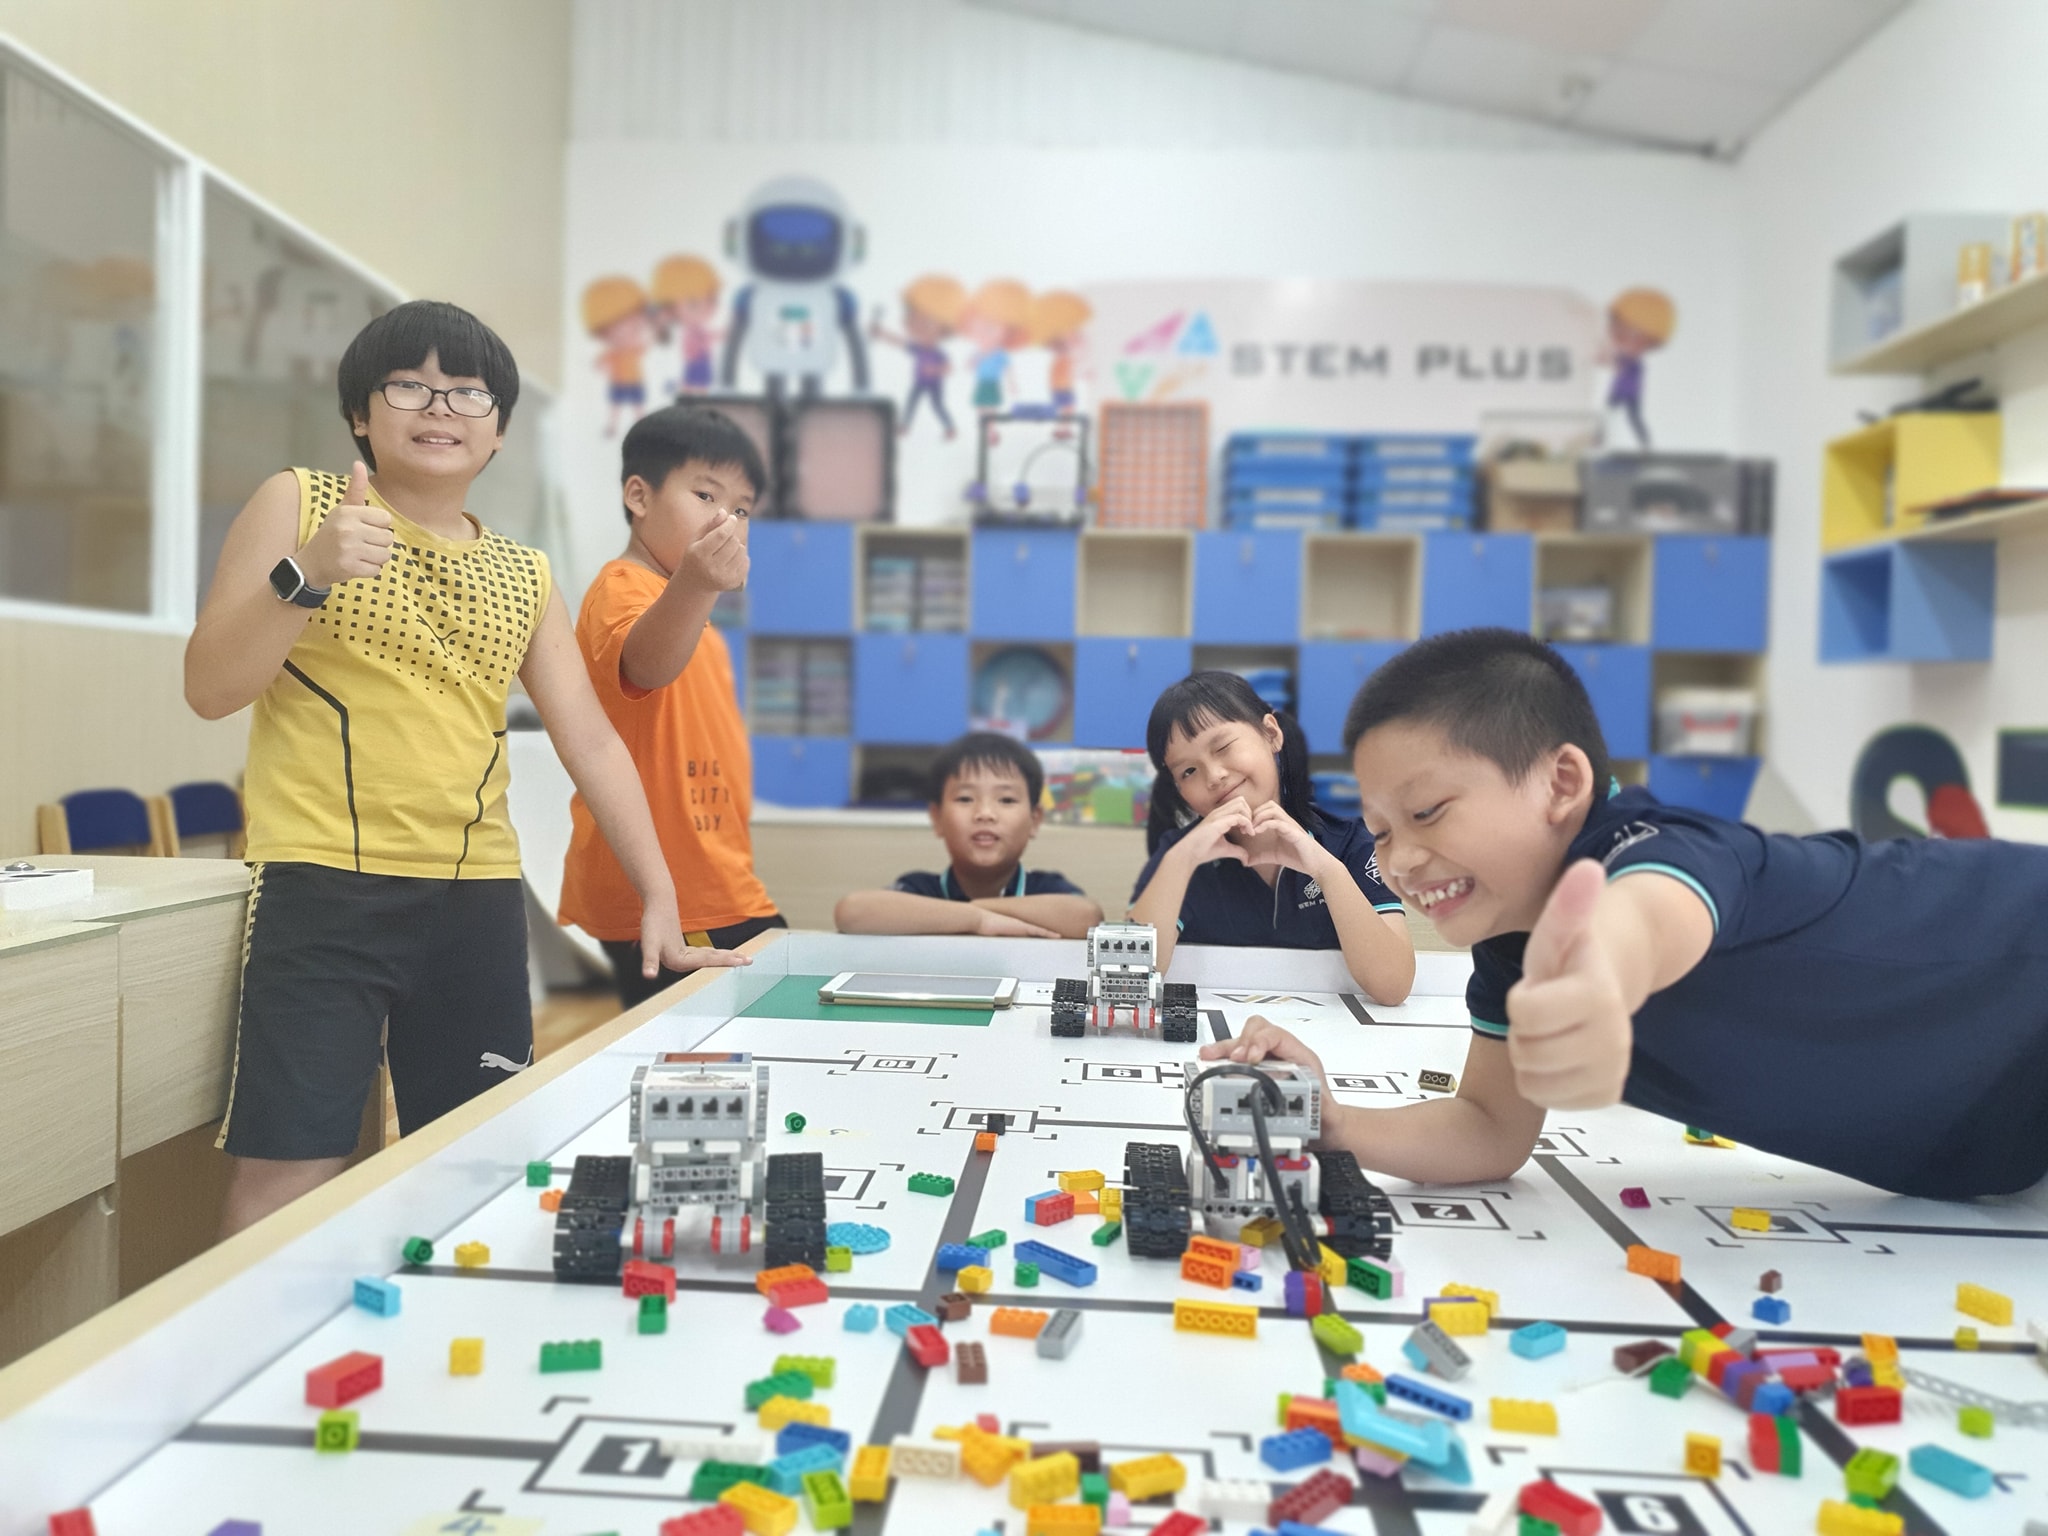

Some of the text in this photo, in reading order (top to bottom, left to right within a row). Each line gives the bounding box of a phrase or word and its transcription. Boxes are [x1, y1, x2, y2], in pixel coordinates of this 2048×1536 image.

[1230, 343, 1574, 381] STEM PLUS
[687, 760, 721, 777] BIG
[619, 1439, 654, 1473] 1
[1623, 1496, 1681, 1532] 6
